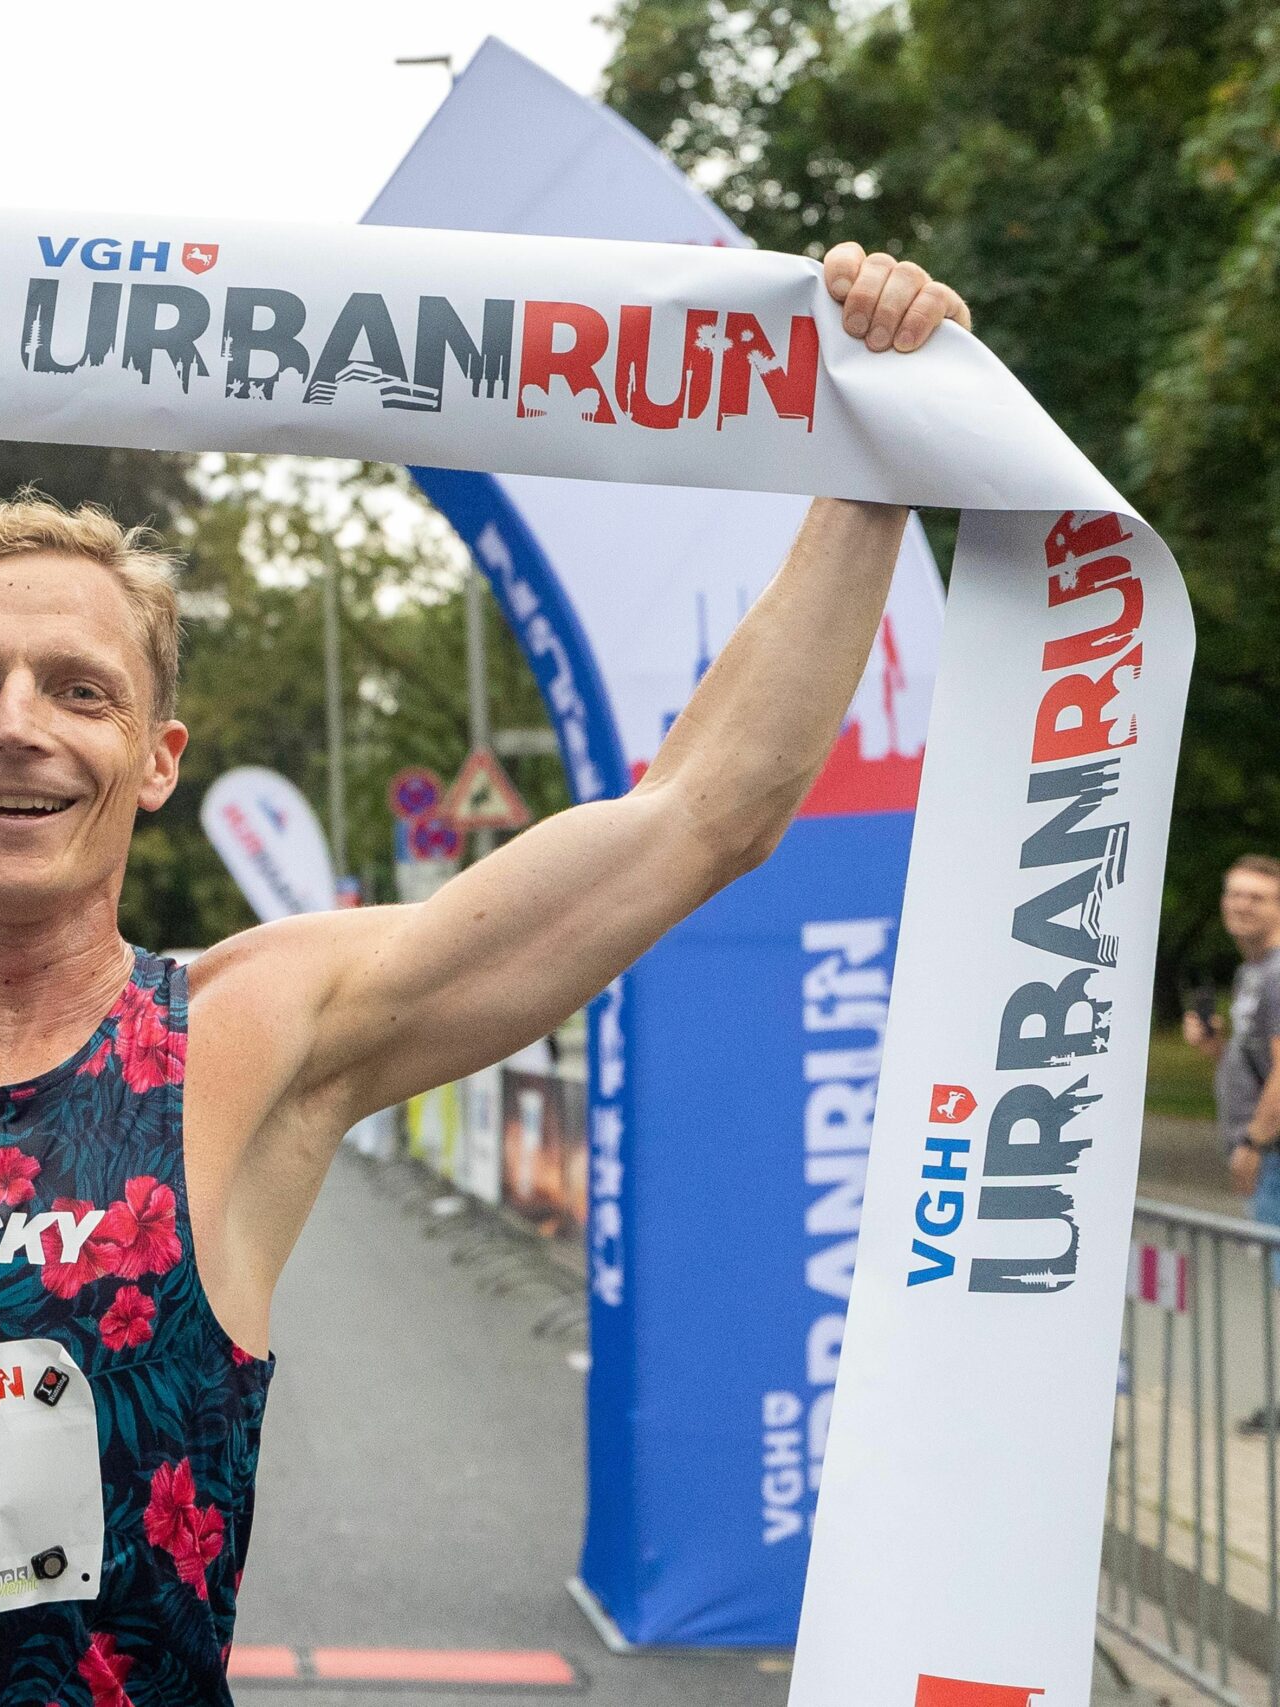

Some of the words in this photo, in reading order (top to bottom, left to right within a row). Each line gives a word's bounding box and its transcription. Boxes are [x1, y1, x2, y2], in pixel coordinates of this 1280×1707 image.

[37, 236, 170, 273] VGH
[20, 277, 820, 433] URBANRUN
[907, 1137, 972, 1288] VGH
[761, 1427, 804, 1547] VGH
